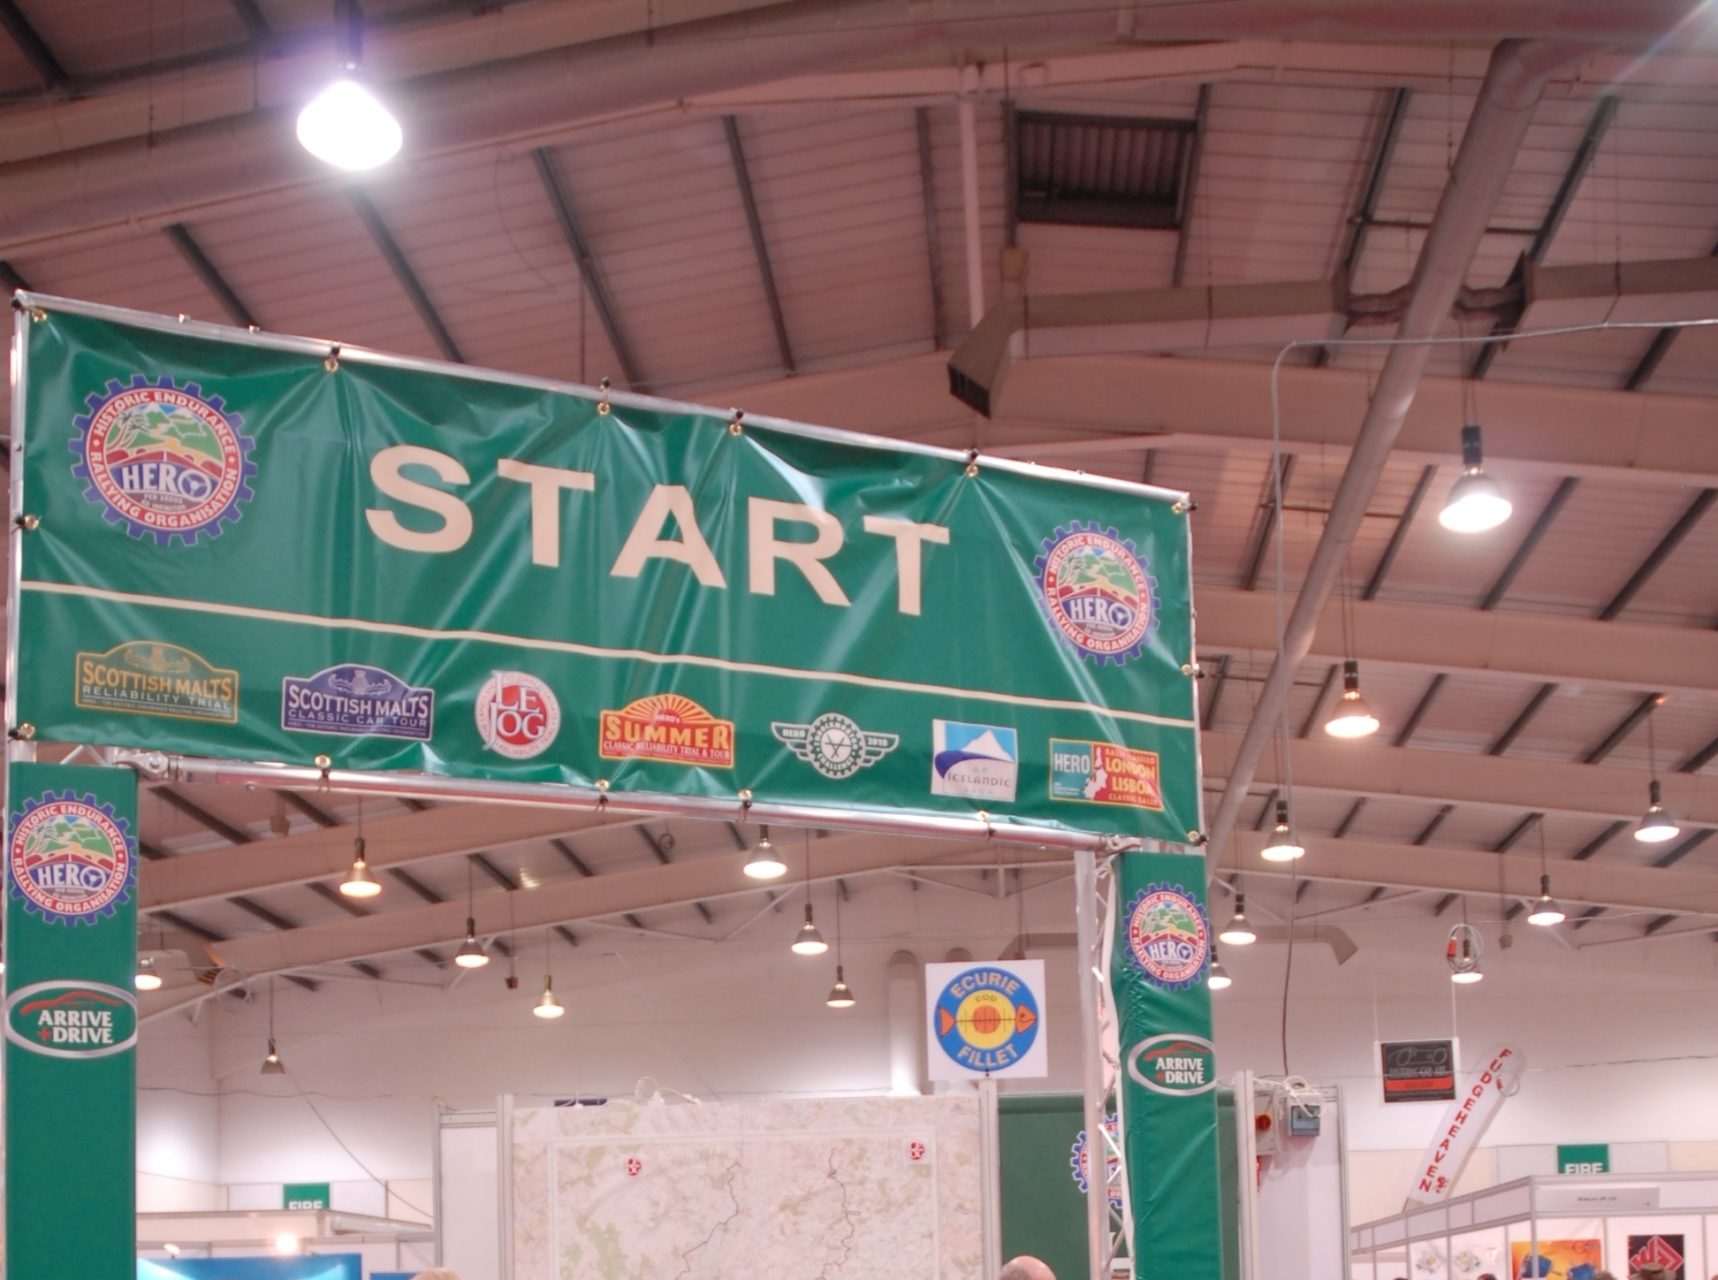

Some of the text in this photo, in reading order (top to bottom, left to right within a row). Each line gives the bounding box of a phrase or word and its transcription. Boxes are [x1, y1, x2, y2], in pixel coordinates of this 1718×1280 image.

[94, 391, 237, 455] HISTORIC ENDURANCE
[90, 451, 238, 527] RALLYING ORGANISATION
[121, 463, 212, 502] HERO
[366, 445, 950, 616] START
[1050, 535, 1145, 589] HISTORIC ENDURANCE
[1047, 587, 1149, 650] RALLYING ORGANISATION
[1070, 598, 1132, 630] HERO
[83, 660, 232, 701] SCOTTISH MALTS
[82, 685, 180, 704] RELIABILITY
[189, 695, 231, 711] TRIAL
[288, 684, 428, 718] SCOTTISH MALTS
[288, 708, 427, 727] CLASSIC CAR TOUR
[605, 715, 730, 749] SUMMER
[1054, 753, 1090, 774] HERO
[1106, 757, 1156, 779] LONDON
[16, 805, 123, 850] HISTORIC ENDURANCE
[14, 858, 125, 912] RALLYING ORGANISATION
[38, 864, 106, 891] HERO
[1149, 941, 1193, 962] HERO
[950, 972, 1020, 998] ECURIE
[975, 994, 997, 1002] COD
[38, 1009, 113, 1027] ARRIVE
[957, 1043, 1018, 1066] FILLET
[1156, 1057, 1204, 1070] ARRIVE
